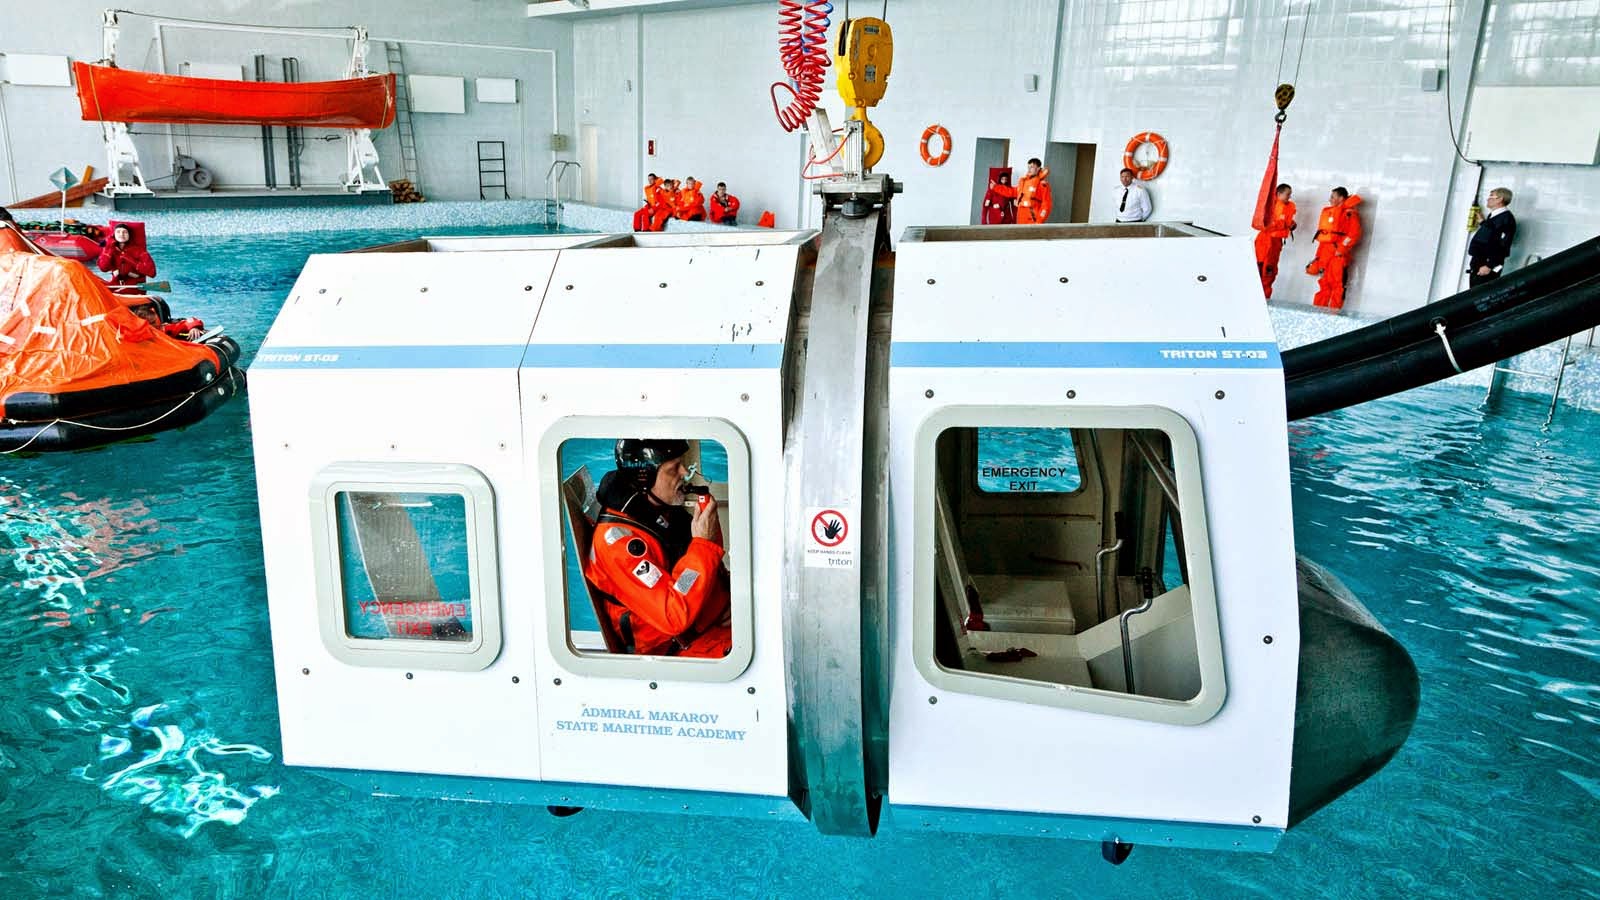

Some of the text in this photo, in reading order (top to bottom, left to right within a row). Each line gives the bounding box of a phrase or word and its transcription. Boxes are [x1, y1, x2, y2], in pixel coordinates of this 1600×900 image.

[303, 353, 339, 362] ST-03
[1160, 349, 1268, 359] TRITON ST-03
[982, 467, 1067, 478] EMERGENCY
[1009, 481, 1039, 491] EXIT
[828, 558, 852, 566] triton
[581, 707, 719, 724] ADMIRAL MAKAROV
[556, 720, 747, 741] STATE MARITIME ACADEMY
